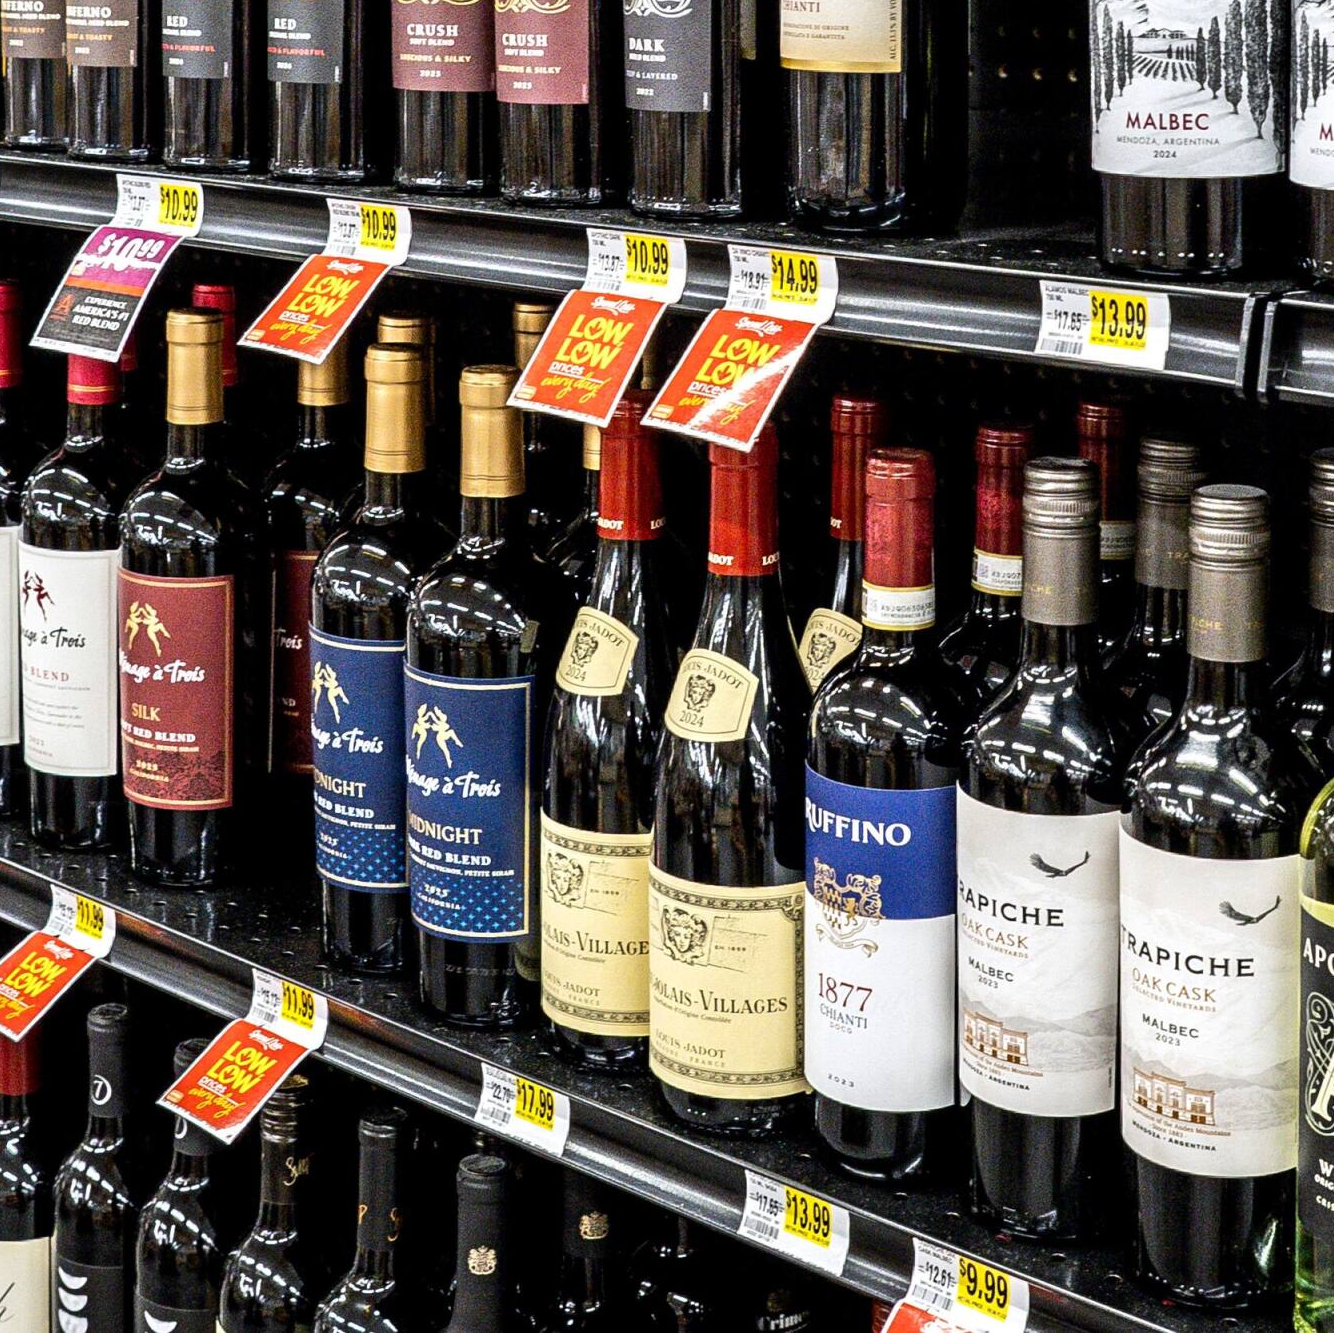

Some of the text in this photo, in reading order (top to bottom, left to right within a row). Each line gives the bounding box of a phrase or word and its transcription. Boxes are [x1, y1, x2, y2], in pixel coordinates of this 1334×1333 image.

[407, 23, 459, 38] CRUSH
[502, 33, 548, 48] CRUSH
[629, 38, 665, 53] DARK
[1125, 112, 1210, 132] MALBEC
[1153, 149, 1177, 159] 2024
[160, 185, 198, 223] $10.99
[360, 204, 397, 243] $10.99
[626, 237, 669, 275] $10.99
[771, 253, 818, 294] $14.99
[1091, 295, 1146, 339] $13.99
[556, 337, 620, 369] LOW
[49, 628, 87, 650] Trois
[166, 658, 206, 684] Trois
[131, 703, 161, 722] SILK
[679, 710, 705, 728] 2024
[154, 729, 196, 744] BLEND
[460, 768, 502, 798] Trois
[805, 804, 912, 848] RUFFINO
[444, 849, 492, 867] BLEND
[77, 894, 104, 931] $11.99
[985, 927, 1029, 951] CASK
[1121, 923, 1256, 978] TRAPICHE
[967, 956, 1015, 984] MALBEC
[977, 975, 999, 990] 2023
[818, 972, 873, 1012] 1877
[1132, 967, 1217, 1004] OAK CASK
[282, 981, 315, 1021] $11.99
[819, 1003, 868, 1030] CHIANTI
[1141, 1013, 1200, 1040] MALBEC
[683, 1042, 725, 1059] JADOT
[1155, 1031, 1181, 1048] 2023
[206, 1059, 265, 1094] LOW
[516, 1078, 555, 1124] $17.99
[786, 1190, 831, 1238] $13.99
[959, 1259, 1008, 1309] $9.99
